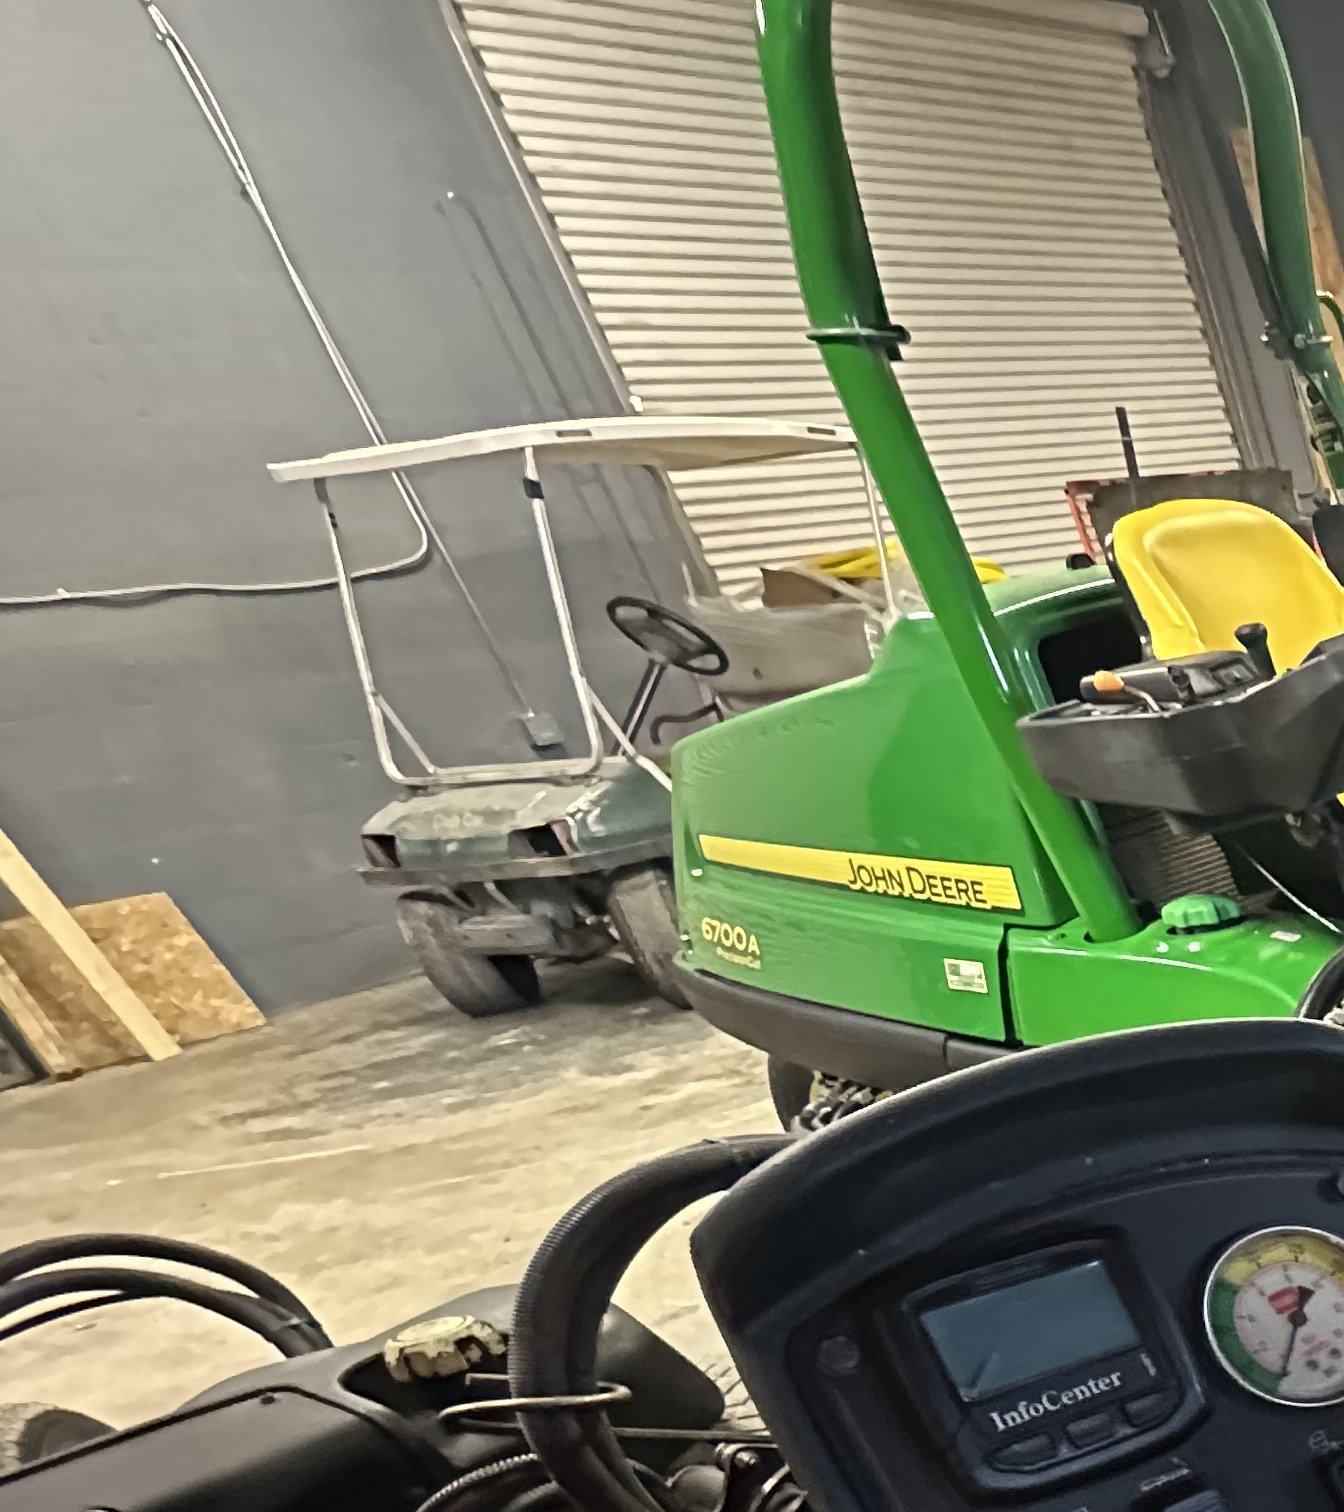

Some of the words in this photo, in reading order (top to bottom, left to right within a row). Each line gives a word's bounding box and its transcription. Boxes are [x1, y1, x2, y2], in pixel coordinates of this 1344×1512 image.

[848, 858, 905, 892] JOHN
[905, 866, 988, 905] DEERE
[701, 917, 761, 956] 6700A
[989, 1371, 1123, 1433] InfoCenter
